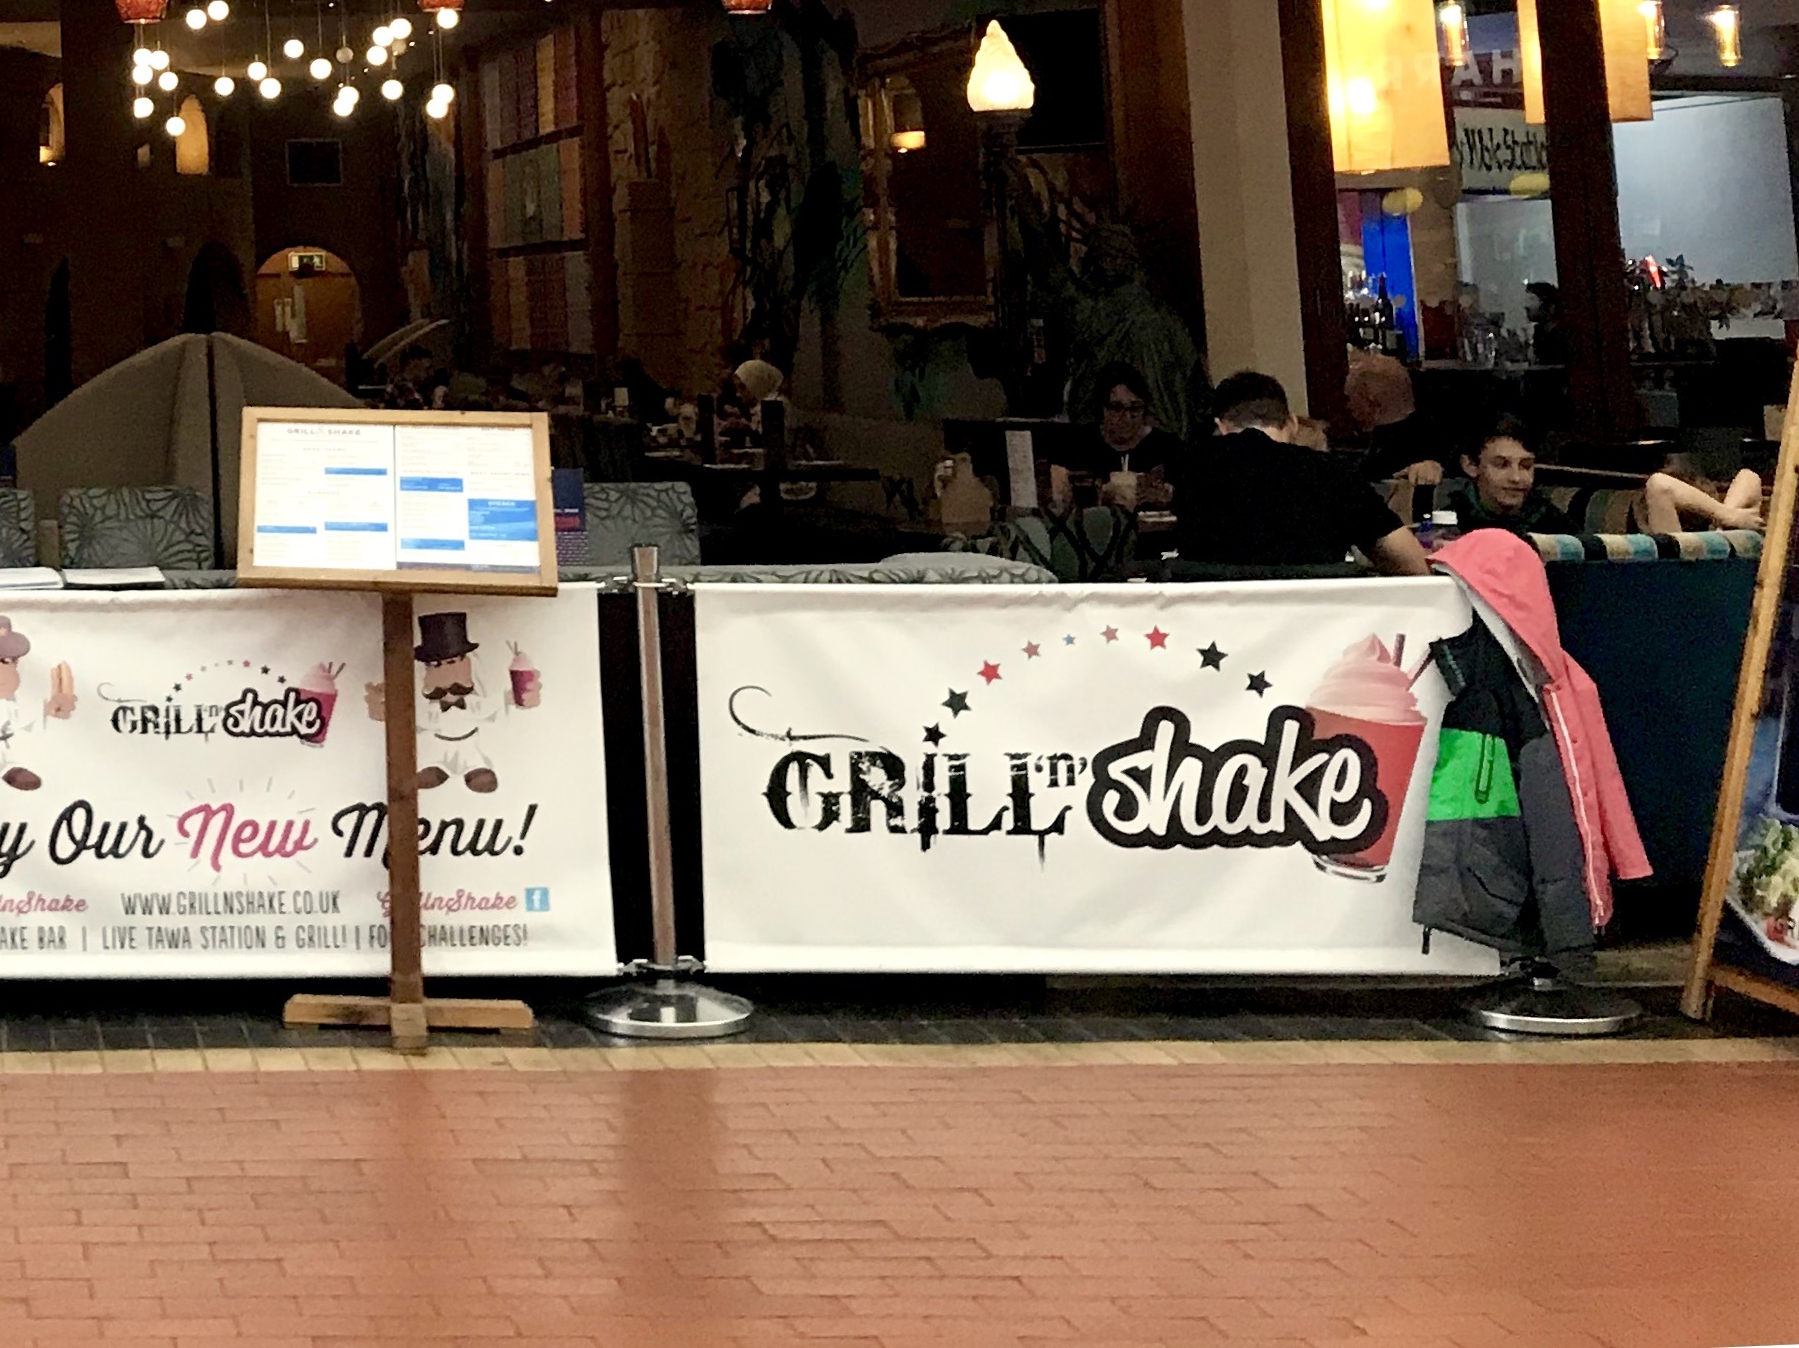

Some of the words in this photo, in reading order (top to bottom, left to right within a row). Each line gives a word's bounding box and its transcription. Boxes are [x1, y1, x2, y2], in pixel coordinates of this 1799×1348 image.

[109, 702, 216, 741] GRILL
[224, 690, 323, 735] shake
[760, 748, 1072, 864] GRILL
[1100, 712, 1375, 842] shake
[48, 798, 166, 866] Our
[176, 802, 319, 872] New
[120, 890, 341, 916] WWW.GRILLNSHAKE.CO.UK
[37, 925, 68, 950] BAR
[102, 925, 137, 950] LIVE
[146, 925, 193, 950] TAWA
[200, 925, 266, 950] STATION
[274, 925, 286, 949] &
[295, 924, 347, 949] GRILL!
